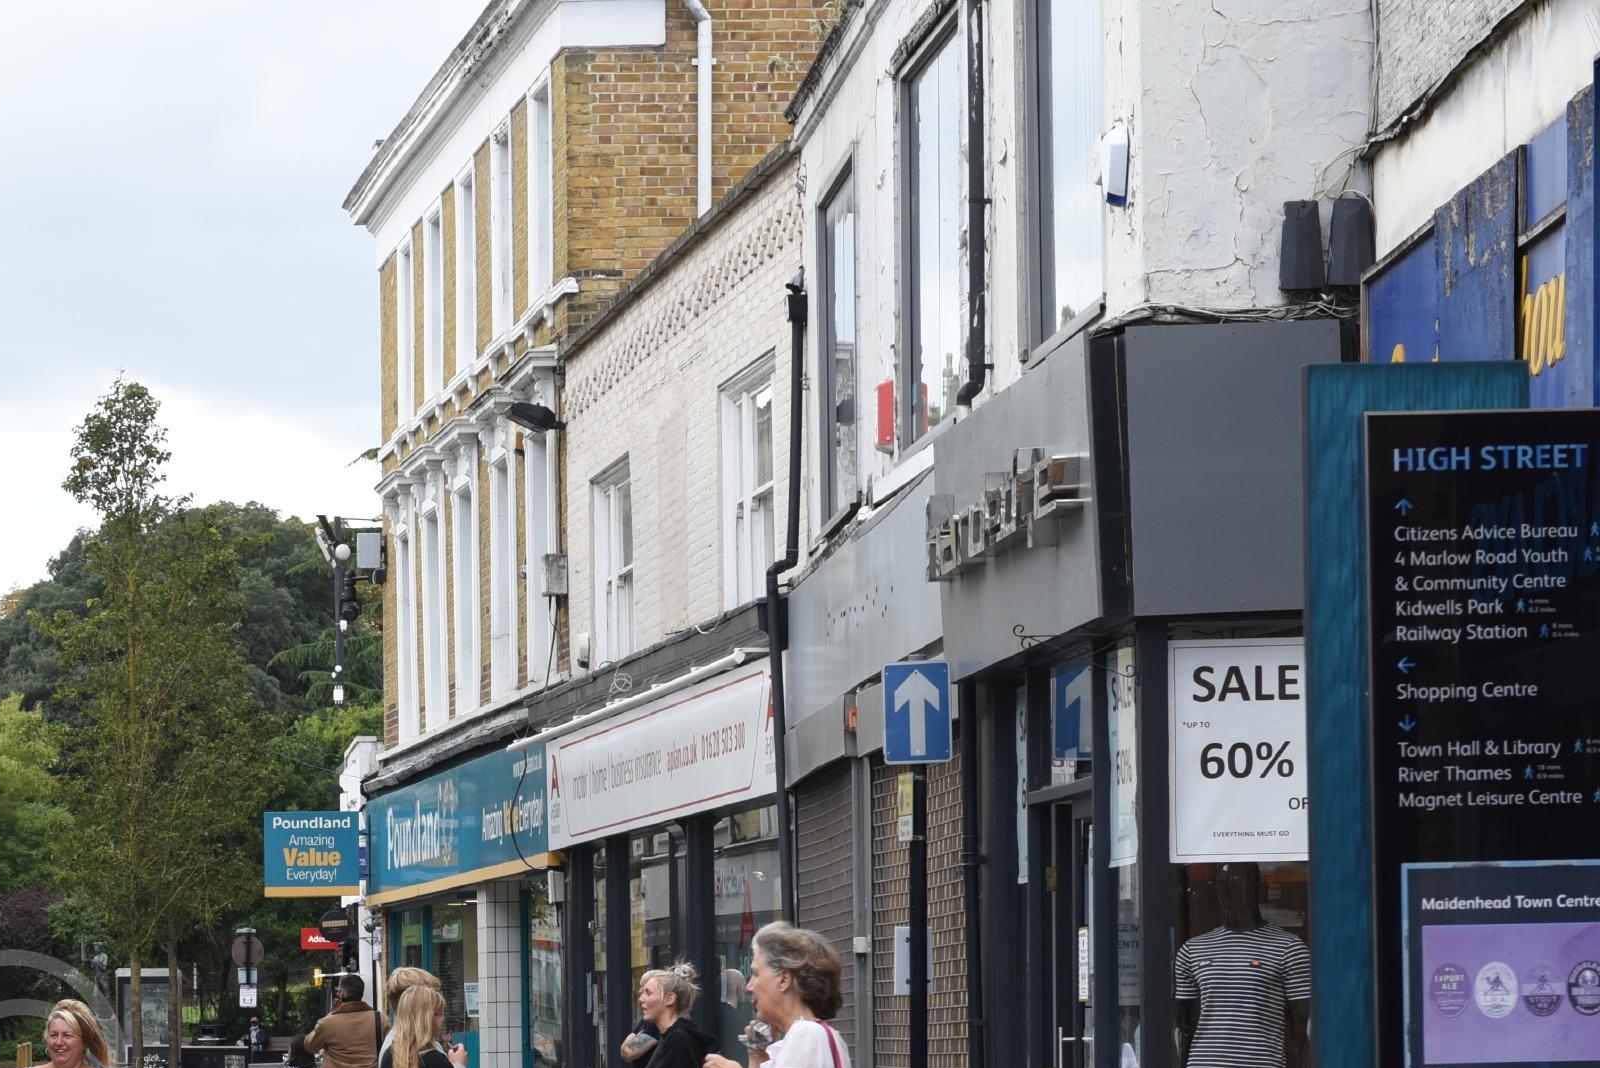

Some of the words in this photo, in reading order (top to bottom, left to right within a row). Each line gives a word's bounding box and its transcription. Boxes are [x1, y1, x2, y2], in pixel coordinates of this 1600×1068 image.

[1393, 446, 1470, 472] HIGH
[1480, 443, 1588, 470] STREET
[1394, 526, 1457, 542] Citizens
[1461, 524, 1516, 540] Advice
[1521, 523, 1578, 539] Bureau
[1394, 551, 1405, 566] 4
[1410, 549, 1471, 566] Marlow
[1475, 549, 1517, 565] Road
[1521, 548, 1568, 563] Youth
[1395, 576, 1408, 591] &
[1412, 575, 1509, 593] Community
[1512, 573, 1566, 589] Centre
[1396, 600, 1463, 616] Kidwells
[1467, 599, 1504, 614] Park
[1396, 625, 1462, 644] Railway
[1466, 624, 1527, 640] Station
[1192, 665, 1300, 702] SALE
[1396, 683, 1477, 702] Shopping
[1482, 681, 1538, 698] Centre
[611, 754, 634, 789] business
[635, 748, 662, 783] insurance
[701, 730, 719, 761] 01628
[734, 721, 745, 751] 300
[1397, 742, 1442, 758] Town
[1447, 741, 1480, 756] Hall
[1484, 741, 1499, 755] &
[1503, 740, 1561, 758] Library
[1199, 741, 1294, 779] 60%
[1398, 767, 1440, 783] River
[1443, 766, 1512, 781] Thames
[1288, 797, 1309, 810] OF
[1398, 793, 1463, 810] Magnet
[1467, 791, 1524, 806] Leisure
[1528, 790, 1583, 804] Centre
[272, 816, 350, 829] Poundland
[387, 783, 441, 870] Poundland
[482, 803, 503, 846] Amazing
[519, 788, 544, 838] Everyday!
[289, 834, 335, 848] Amazing
[283, 848, 342, 866] Value
[286, 868, 337, 883] Everyday!
[1421, 896, 1511, 910] Maidenhead
[1515, 895, 1552, 908] Town
[1556, 894, 1600, 908] Centre
